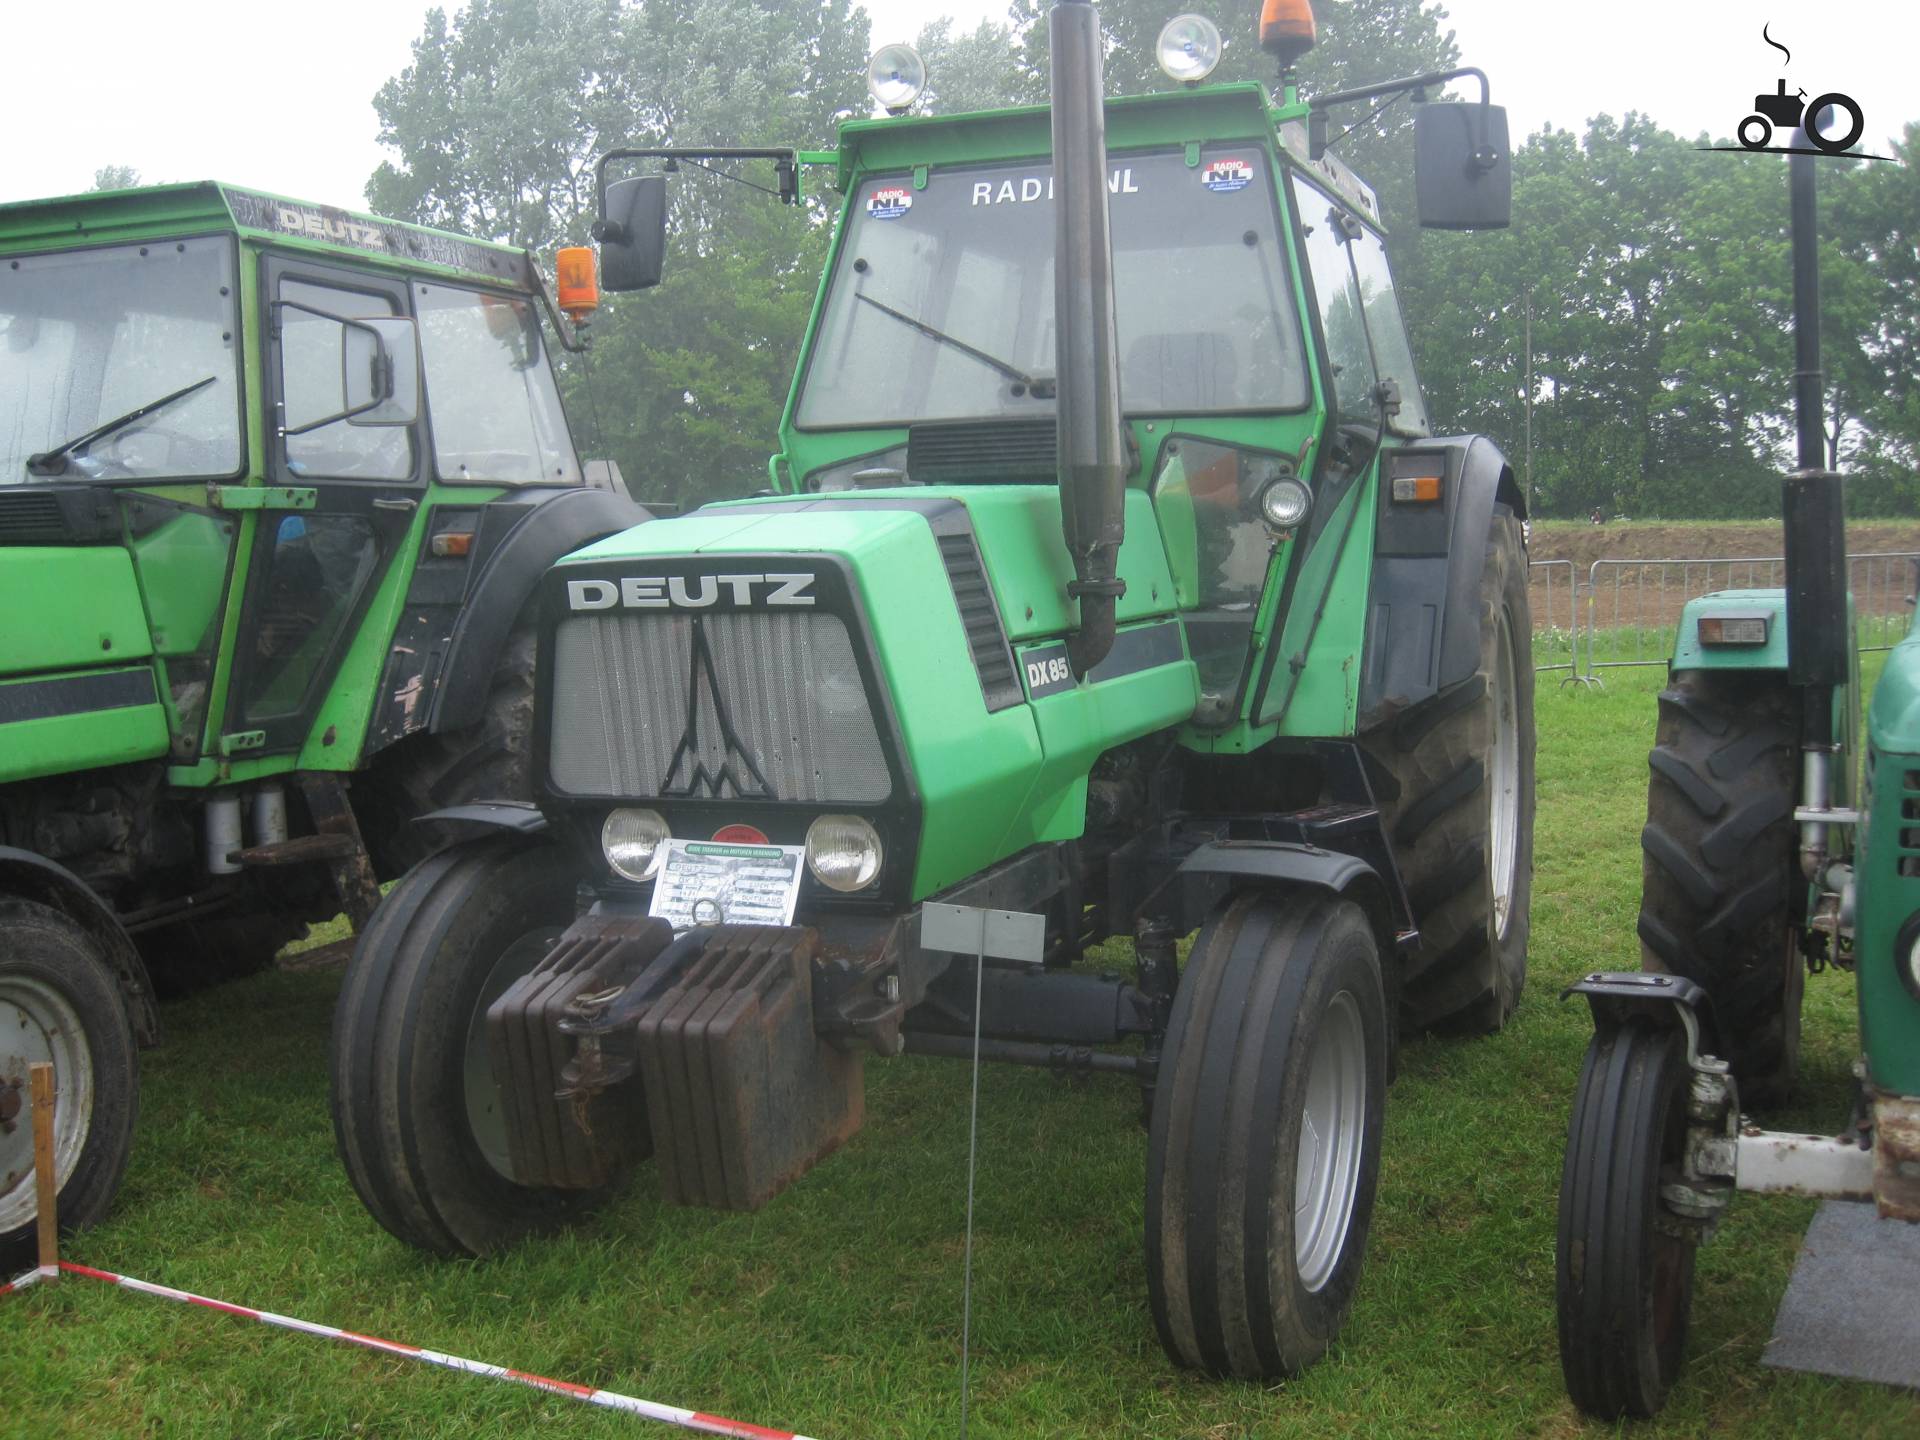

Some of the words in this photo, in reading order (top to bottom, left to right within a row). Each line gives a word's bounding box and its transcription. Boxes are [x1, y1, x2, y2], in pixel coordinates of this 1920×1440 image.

[1213, 161, 1244, 172] RADIO
[1208, 169, 1247, 182] NL
[877, 189, 904, 200] RADIO
[971, 176, 1055, 206] RADI
[872, 198, 906, 210] NL
[279, 208, 383, 247] DEUTZ
[567, 574, 816, 610] DEUTZ
